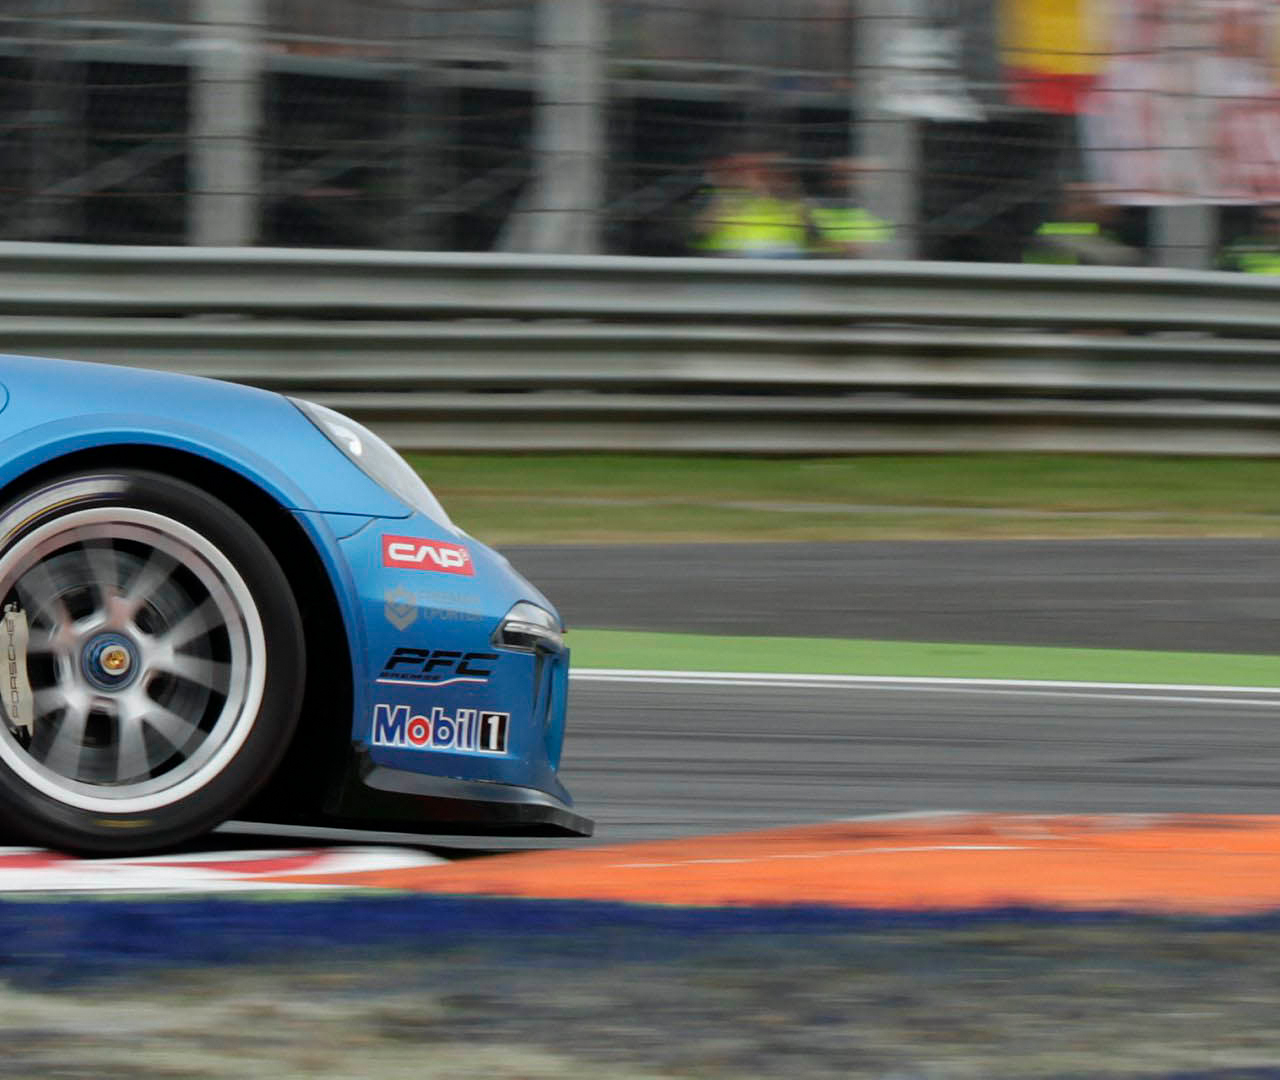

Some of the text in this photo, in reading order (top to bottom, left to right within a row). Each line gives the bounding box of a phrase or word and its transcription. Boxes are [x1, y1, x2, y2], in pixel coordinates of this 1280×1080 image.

[383, 647, 500, 676] PFC
[372, 704, 502, 751] Mobil 1
